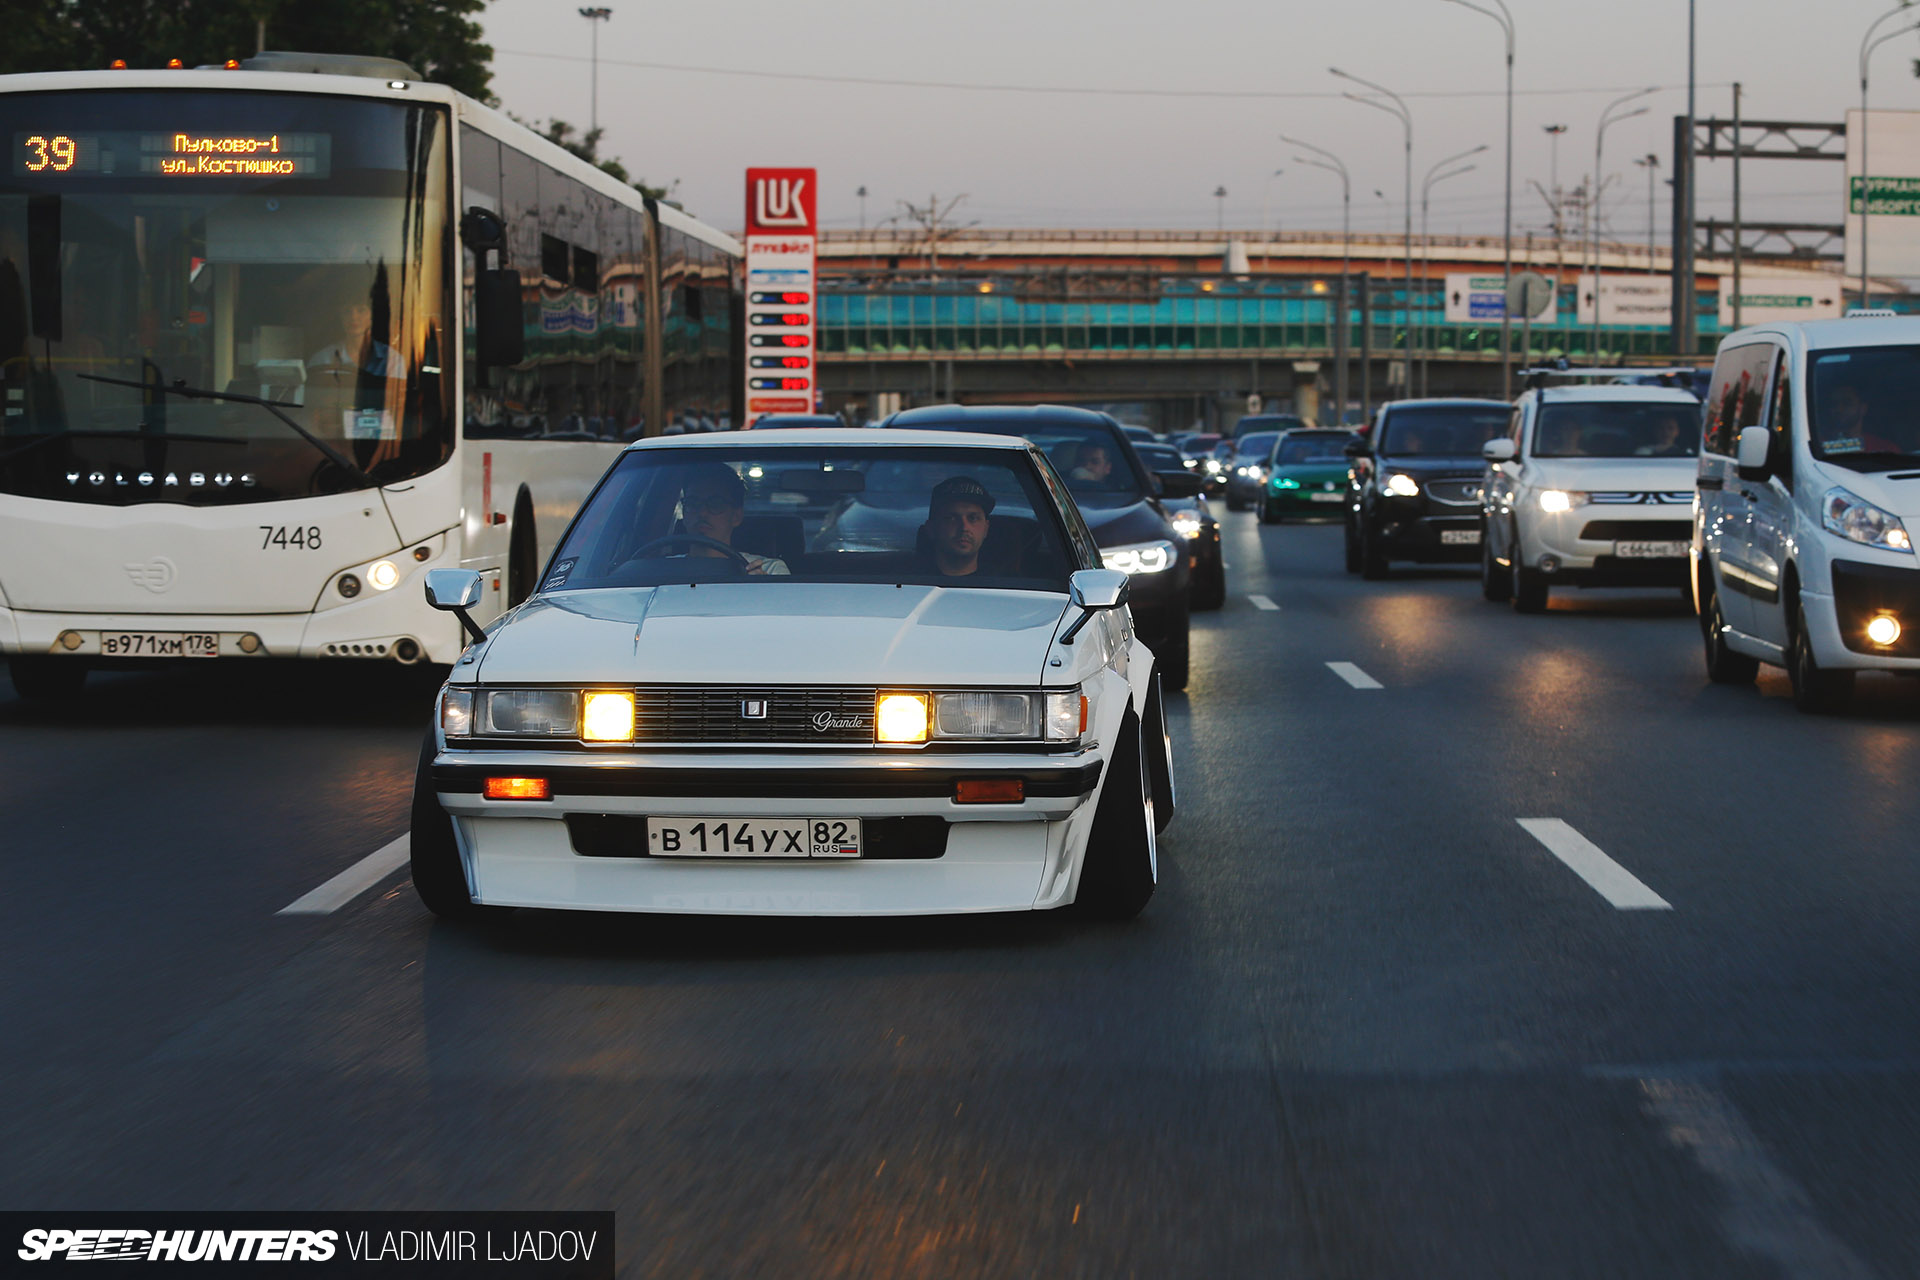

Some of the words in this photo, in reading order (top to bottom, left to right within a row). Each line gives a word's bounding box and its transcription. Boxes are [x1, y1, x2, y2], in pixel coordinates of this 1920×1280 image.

[25, 135, 76, 171] 39
[174, 133, 280, 153] Пулково-1
[66, 471, 257, 487] VOLGABUS
[259, 526, 322, 550] 7448
[185, 635, 214, 649] 178
[812, 710, 864, 733] Grande
[813, 821, 849, 844] 82
[812, 844, 839, 853] RUS
